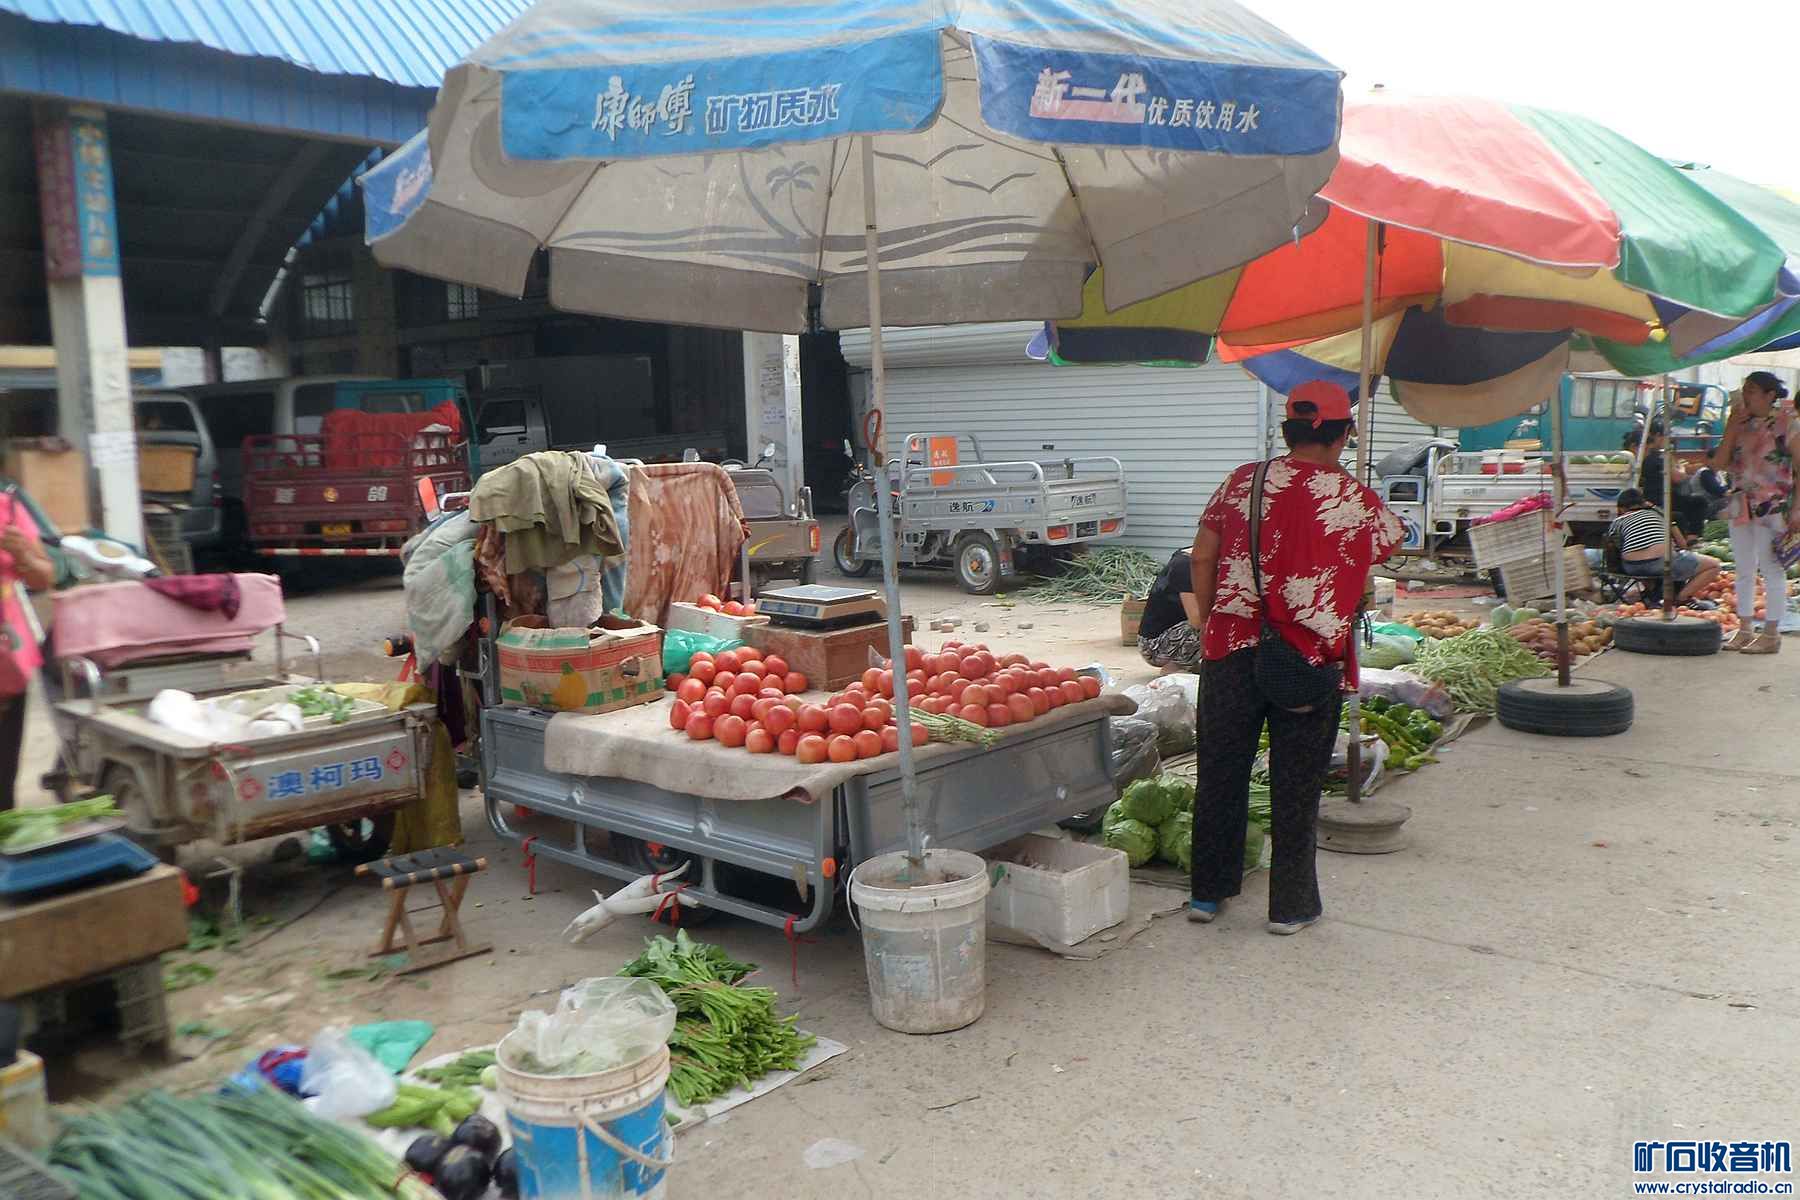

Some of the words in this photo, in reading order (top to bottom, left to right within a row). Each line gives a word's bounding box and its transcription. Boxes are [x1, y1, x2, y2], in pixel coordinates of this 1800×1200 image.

[705, 83, 843, 136] 矿物质水
[1033, 67, 1147, 114] 新一代
[1148, 96, 1260, 133] 优质饮用水
[268, 757, 384, 799] 澳柯玛
